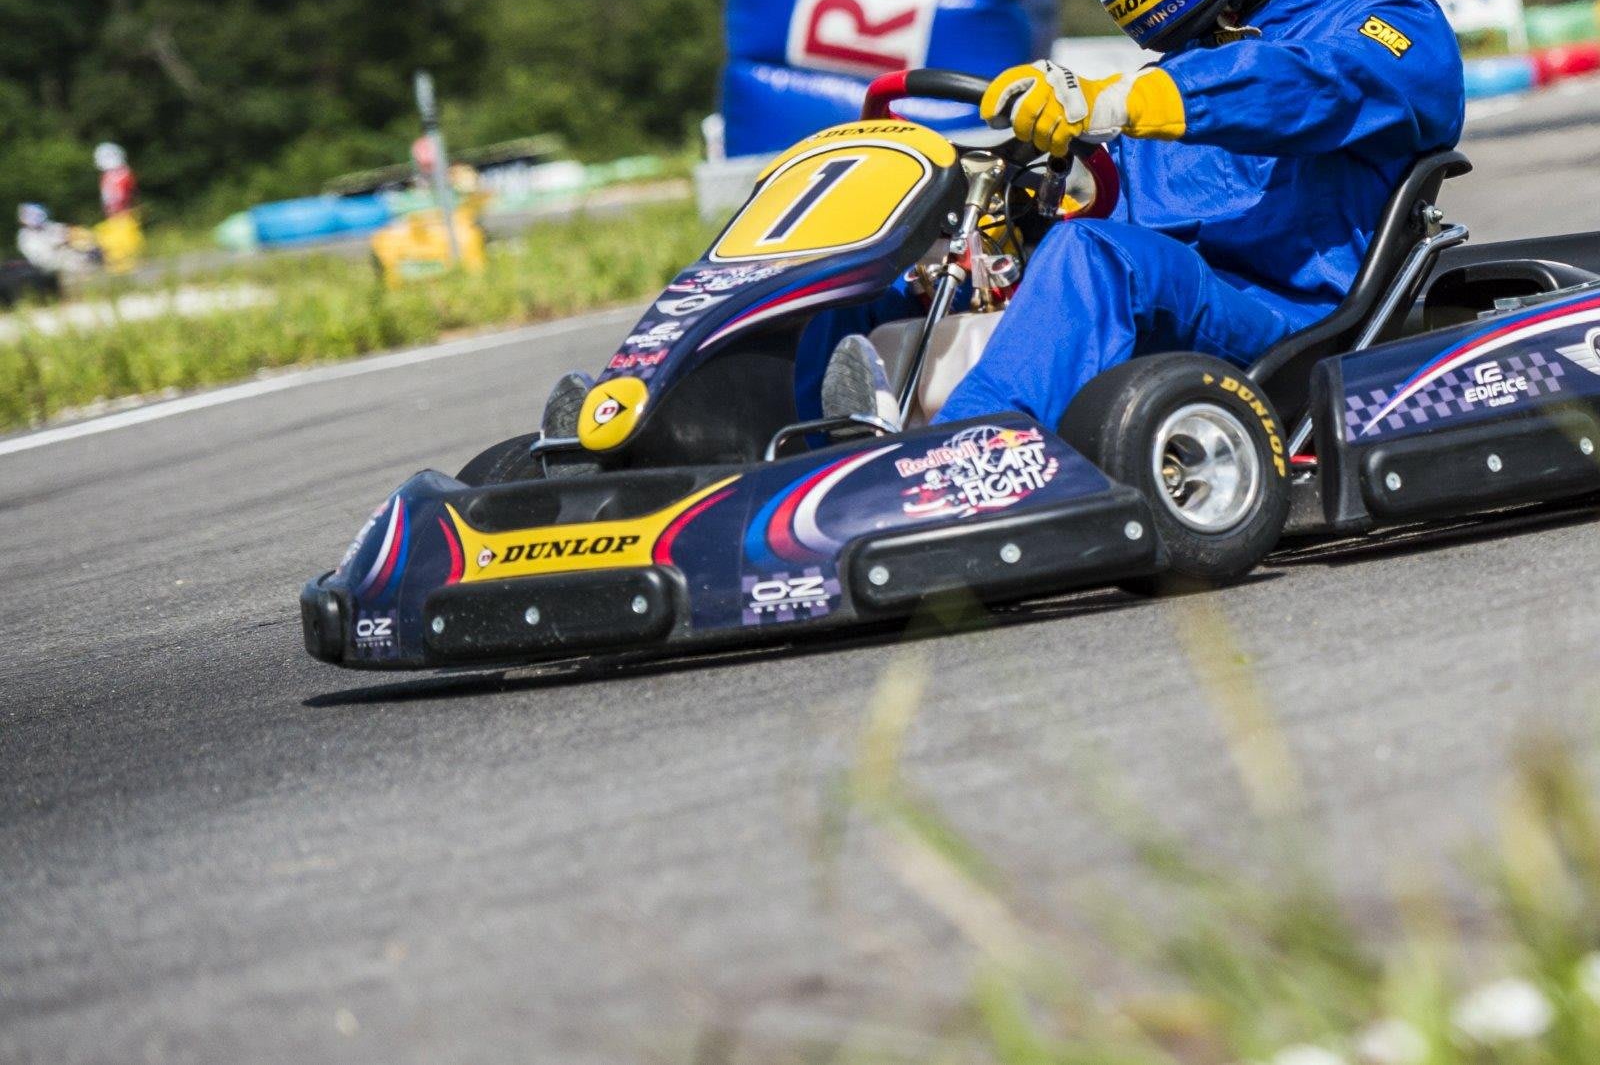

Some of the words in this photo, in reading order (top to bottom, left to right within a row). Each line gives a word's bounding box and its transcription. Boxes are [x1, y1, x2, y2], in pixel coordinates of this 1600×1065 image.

[1363, 17, 1410, 53] OMP
[824, 125, 917, 139] DUNLOP
[759, 156, 863, 244] 1
[1464, 375, 1529, 403] EDIFICE
[1219, 375, 1286, 478] DUNLOP
[896, 448, 939, 477] Red
[935, 440, 980, 462] Bull
[970, 442, 1046, 477] KART
[962, 465, 1046, 507] FIGHT
[499, 534, 641, 565] DUNLOP
